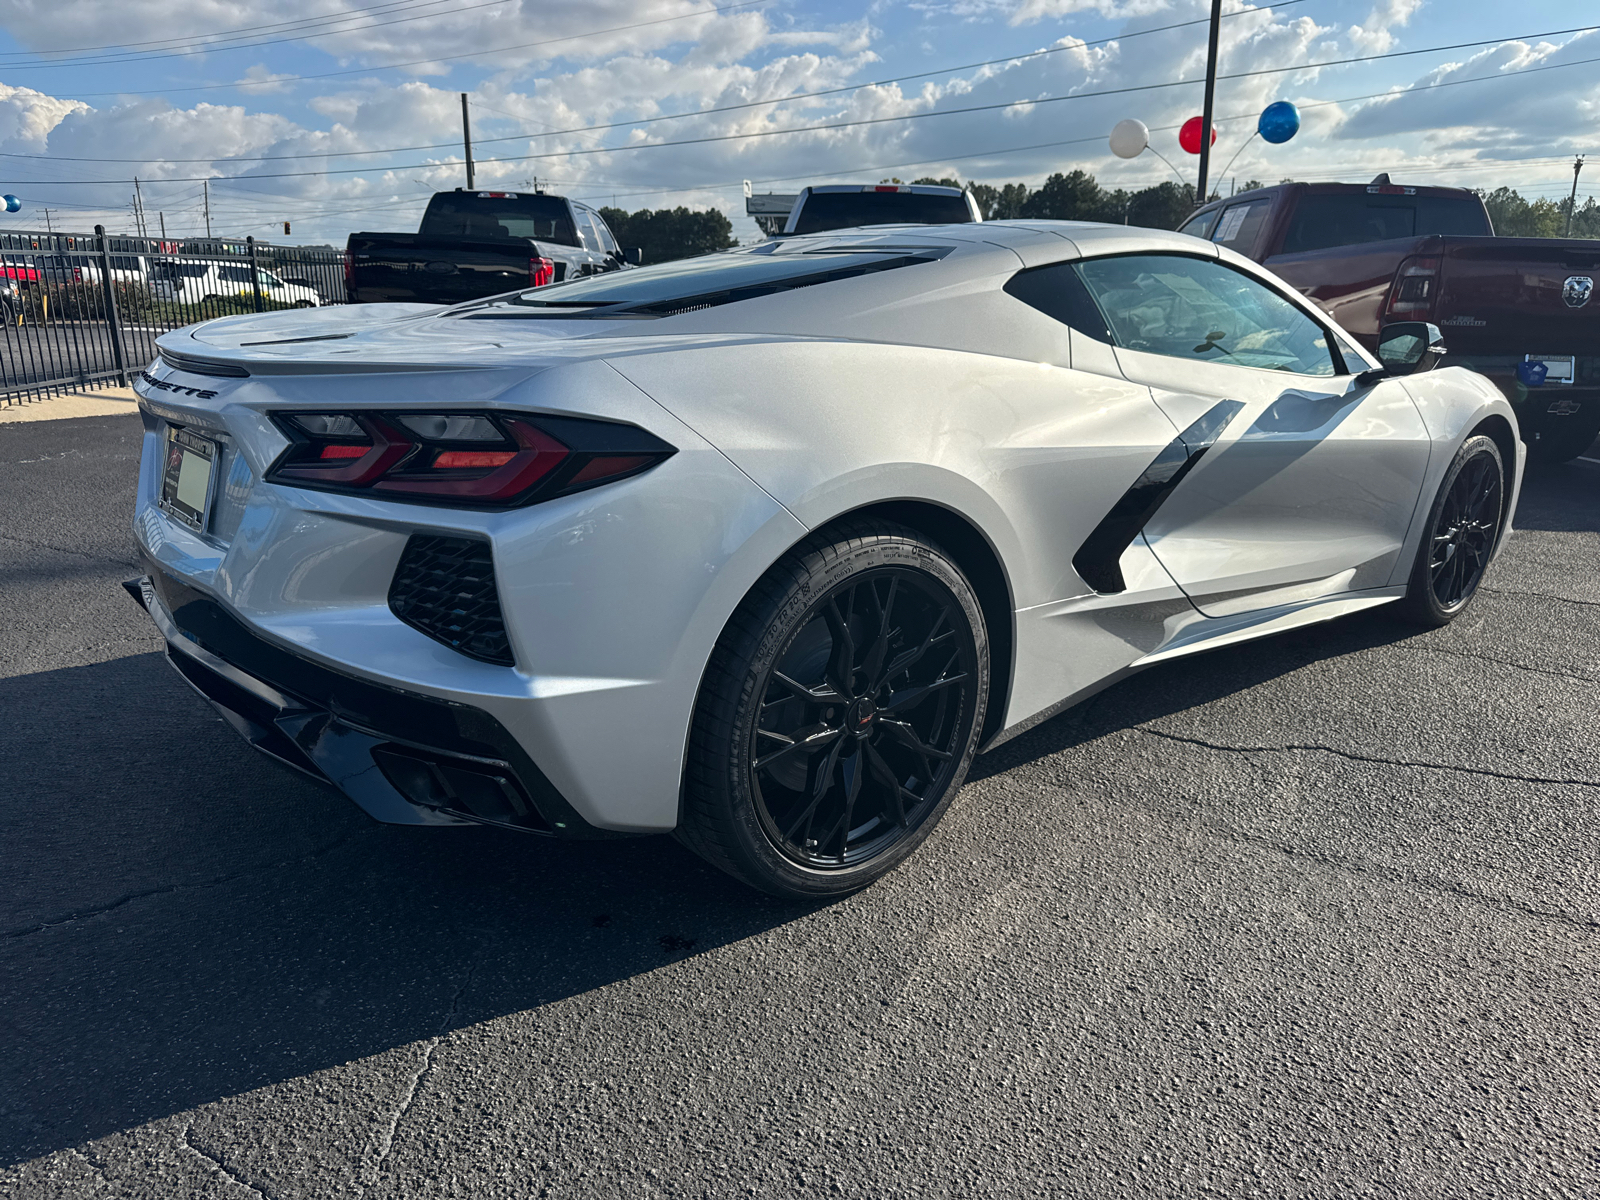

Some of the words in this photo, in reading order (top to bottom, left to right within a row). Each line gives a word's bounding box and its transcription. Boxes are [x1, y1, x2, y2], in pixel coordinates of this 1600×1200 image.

[778, 609, 789, 626] ZR
[789, 596, 800, 610] 20
[730, 672, 758, 782] MICHELIN
[951, 688, 965, 747] CORVETTE
